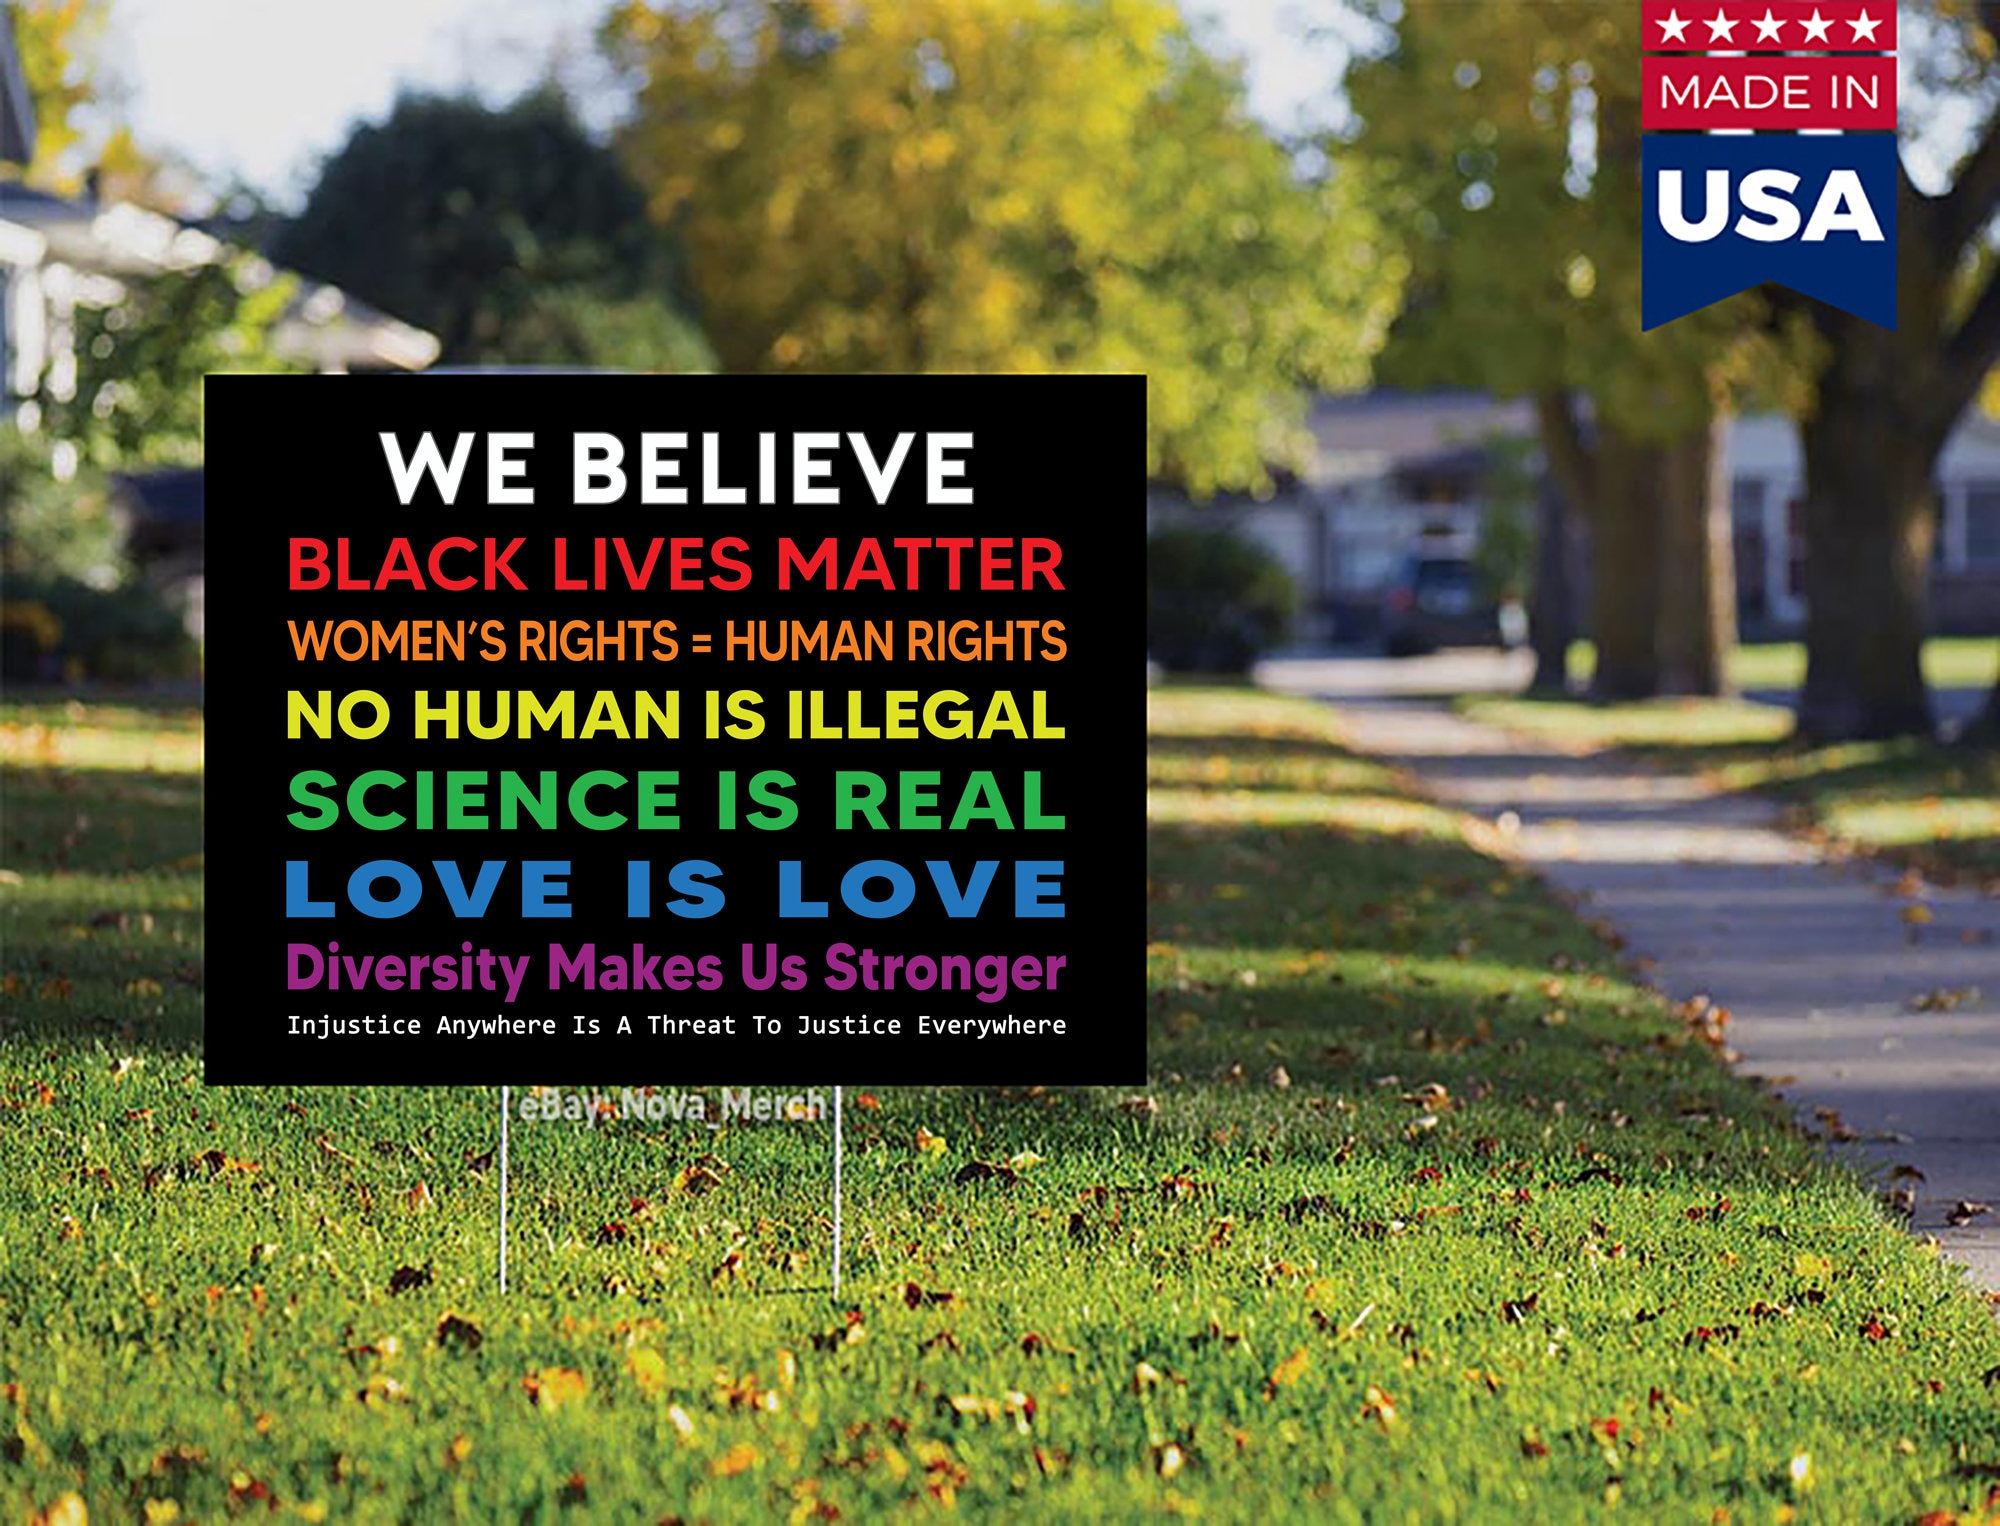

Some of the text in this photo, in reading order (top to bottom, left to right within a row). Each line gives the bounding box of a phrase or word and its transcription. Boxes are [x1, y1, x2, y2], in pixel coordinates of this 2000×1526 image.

[379, 431, 974, 506] WE BELIEVE
[289, 537, 1066, 592] BLACK LIVES MATTER
[519, 619, 679, 662] RIGHTS
[692, 632, 712, 655] =
[726, 619, 894, 662] HUMAN
[908, 619, 1068, 662] RIGHTS
[287, 689, 1066, 740] NO HUMAN IS ILLEGAL
[286, 769, 1066, 831] SCIENCE IS REAL
[285, 859, 1066, 919] LOVE IS LOVE
[287, 941, 1067, 1003] Diversity Makes Us Stronger
[288, 1014, 1067, 1040] Injustice Anywhere Is A Threat To Justice Everywhere
